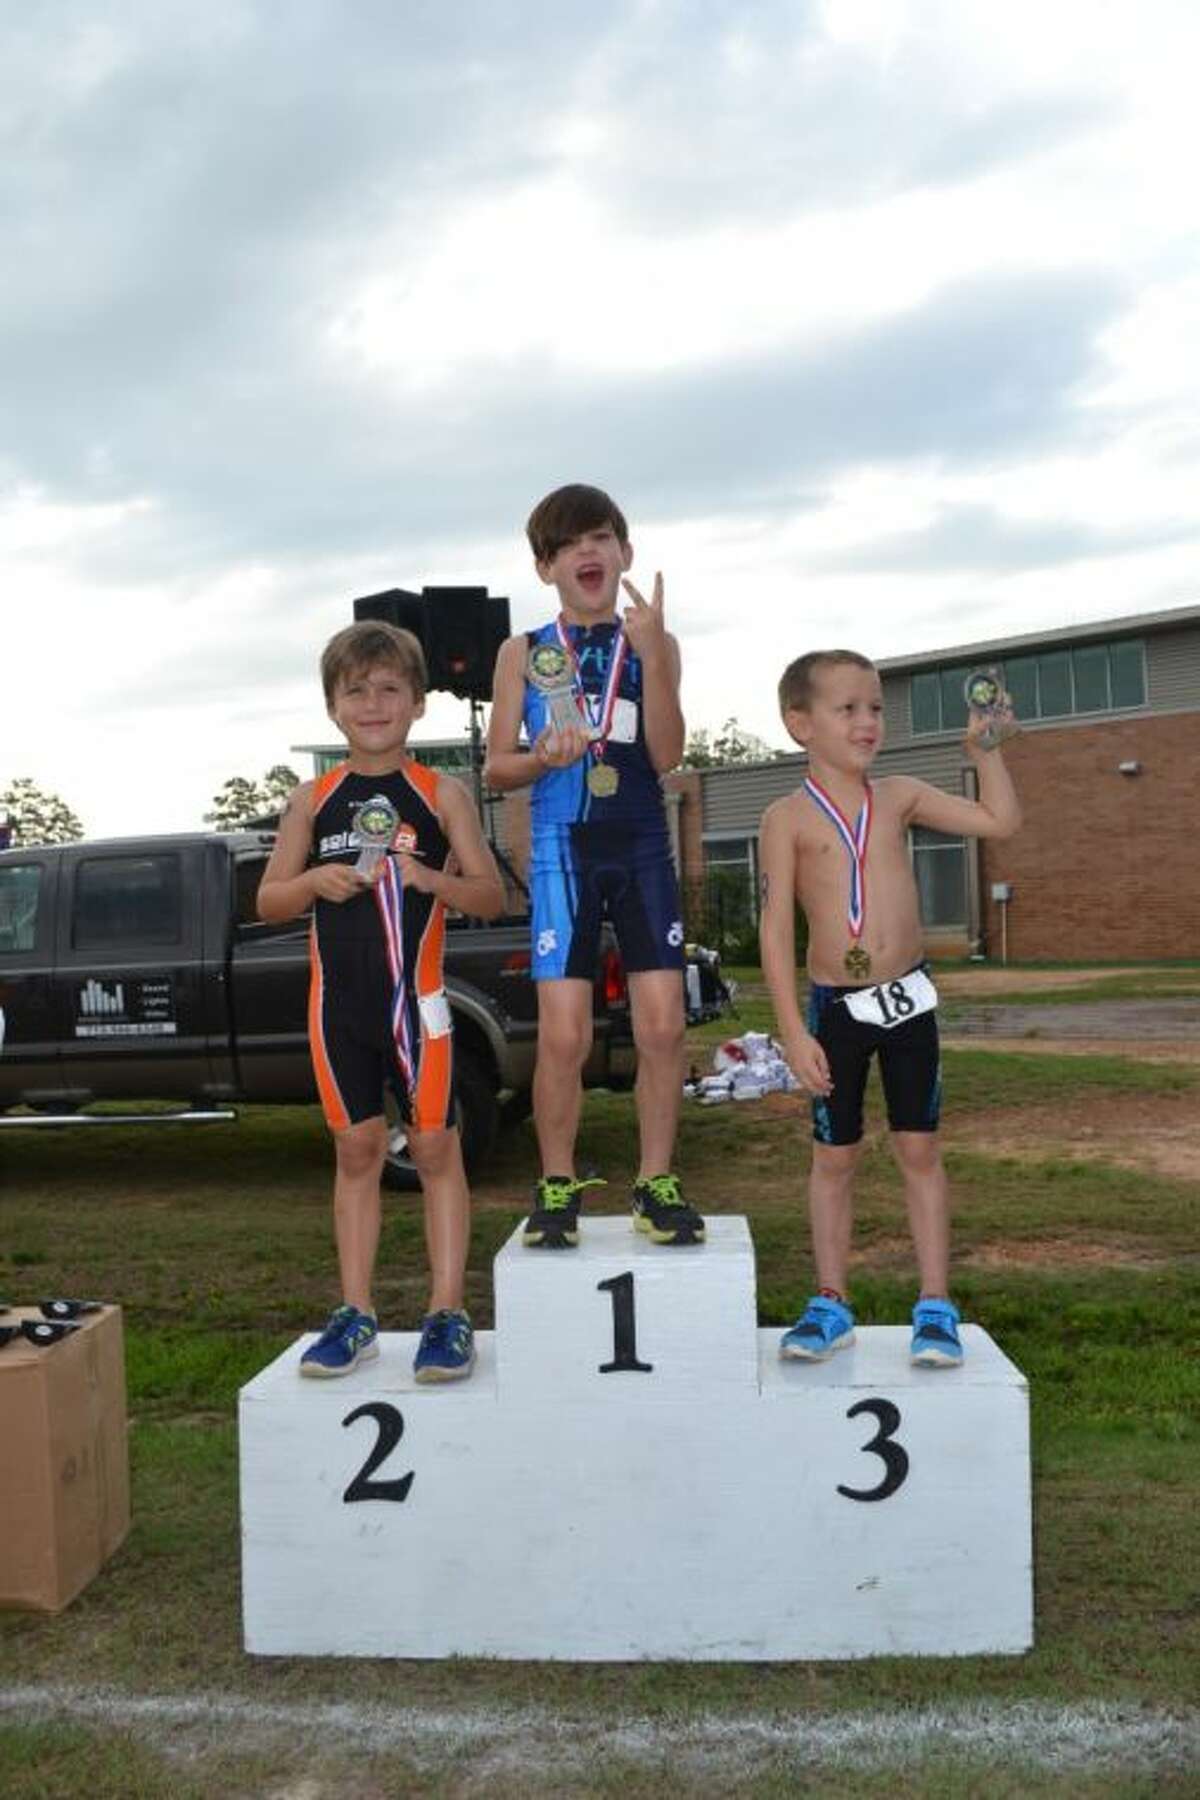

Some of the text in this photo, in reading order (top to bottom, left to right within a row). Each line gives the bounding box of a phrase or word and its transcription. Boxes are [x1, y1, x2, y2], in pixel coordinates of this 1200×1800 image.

[870, 981, 915, 1025] 18
[597, 1271, 653, 1374] 1
[341, 1401, 415, 1504] 2
[836, 1398, 910, 1503] 3
